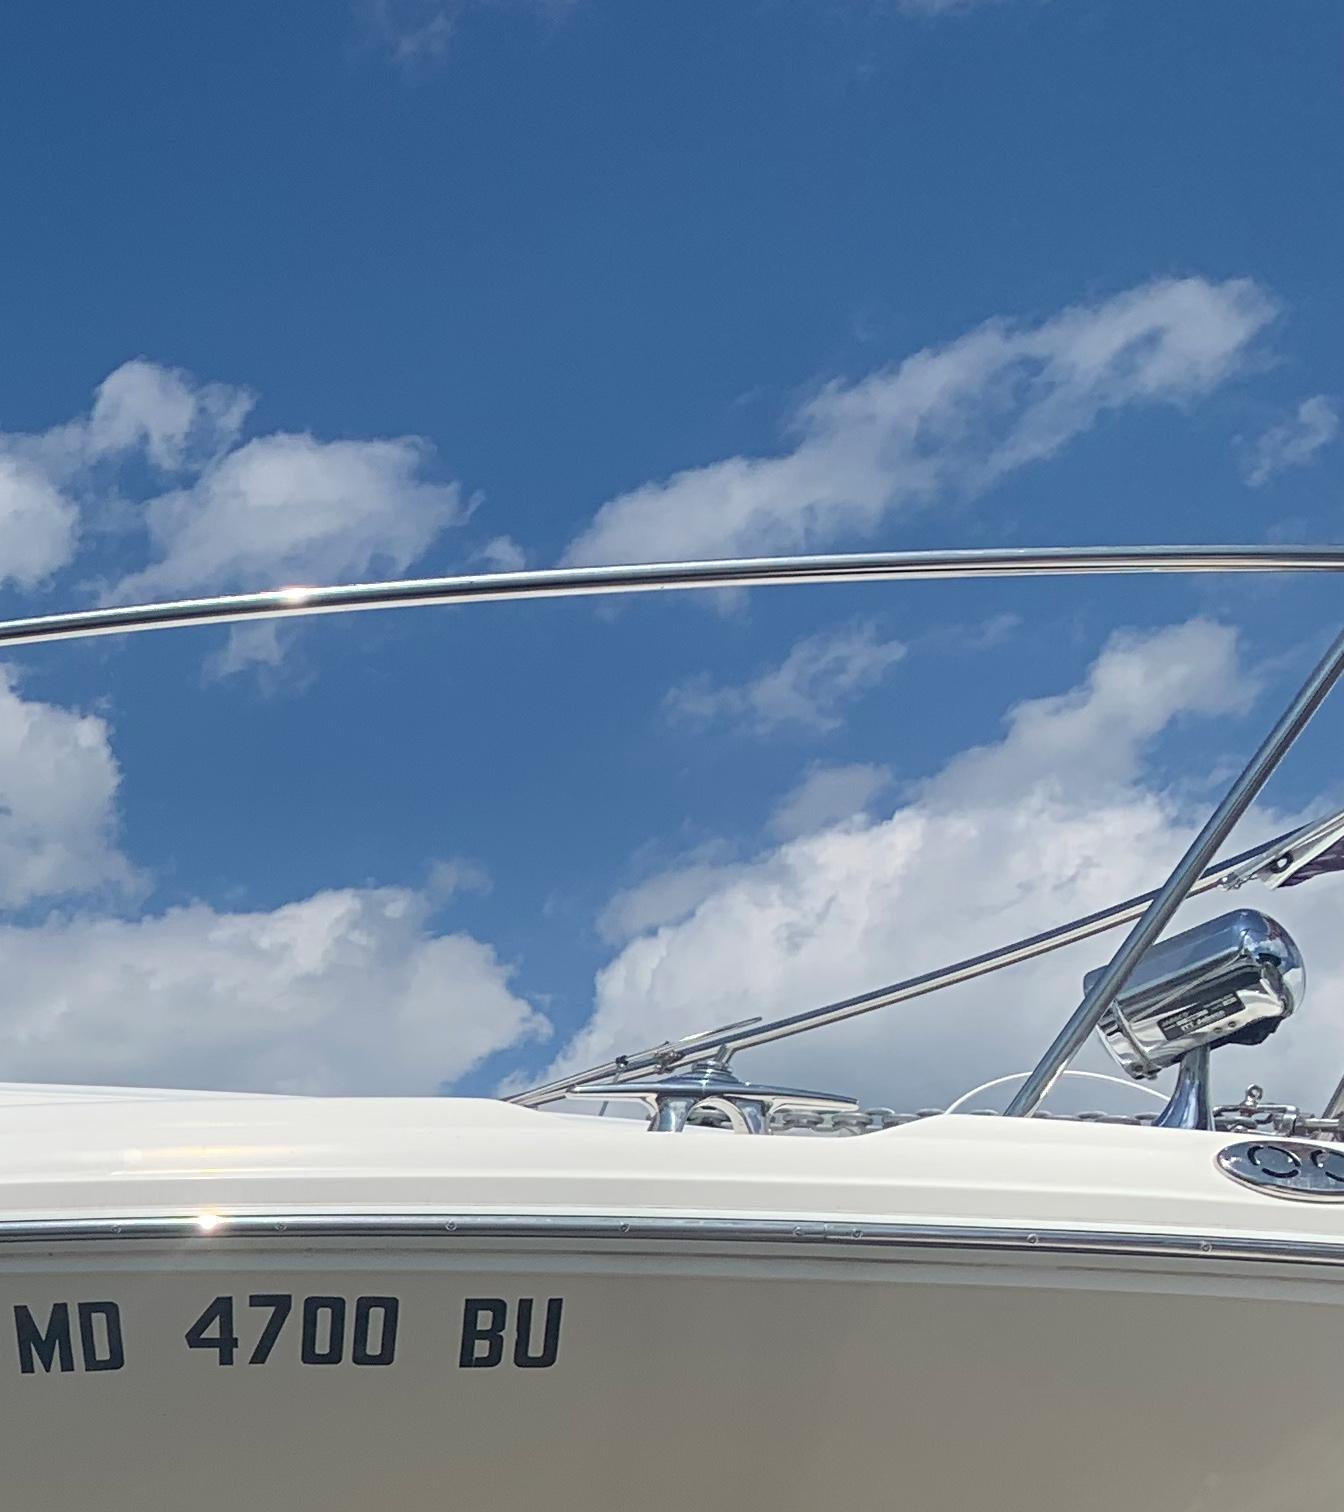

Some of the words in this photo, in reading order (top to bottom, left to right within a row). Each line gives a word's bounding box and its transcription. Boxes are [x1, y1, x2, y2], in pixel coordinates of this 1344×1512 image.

[13, 1301, 125, 1374] MD
[185, 1294, 399, 1366] 4700
[459, 1297, 563, 1368] BU
